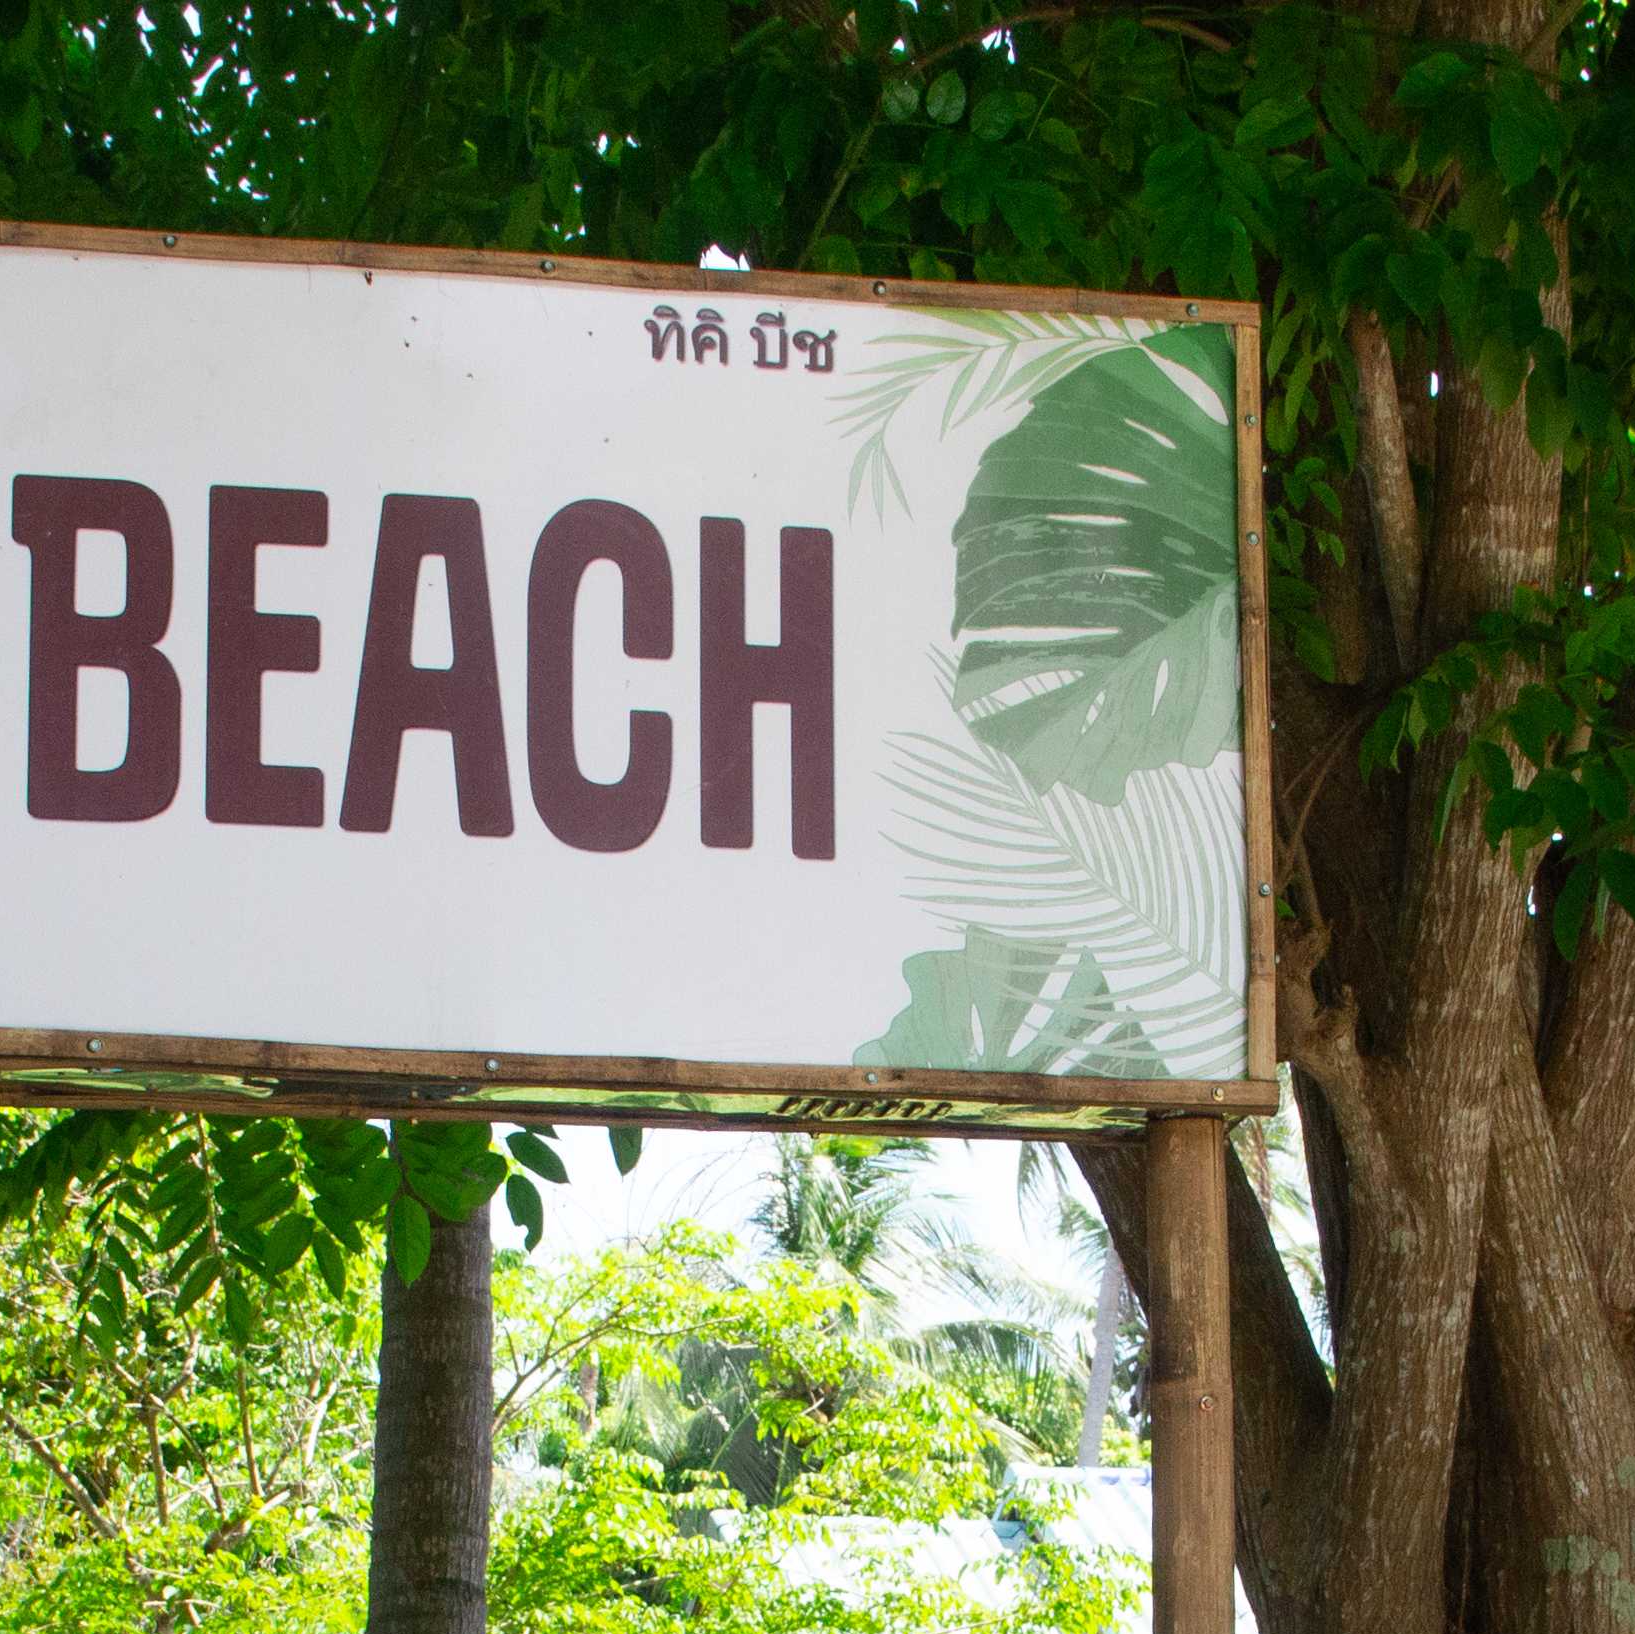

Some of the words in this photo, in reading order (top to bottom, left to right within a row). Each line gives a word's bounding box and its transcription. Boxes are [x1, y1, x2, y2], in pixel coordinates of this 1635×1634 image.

[644, 304, 729, 366] ทิคิ
[749, 312, 837, 373] บีช
[11, 473, 837, 861] BEACH
